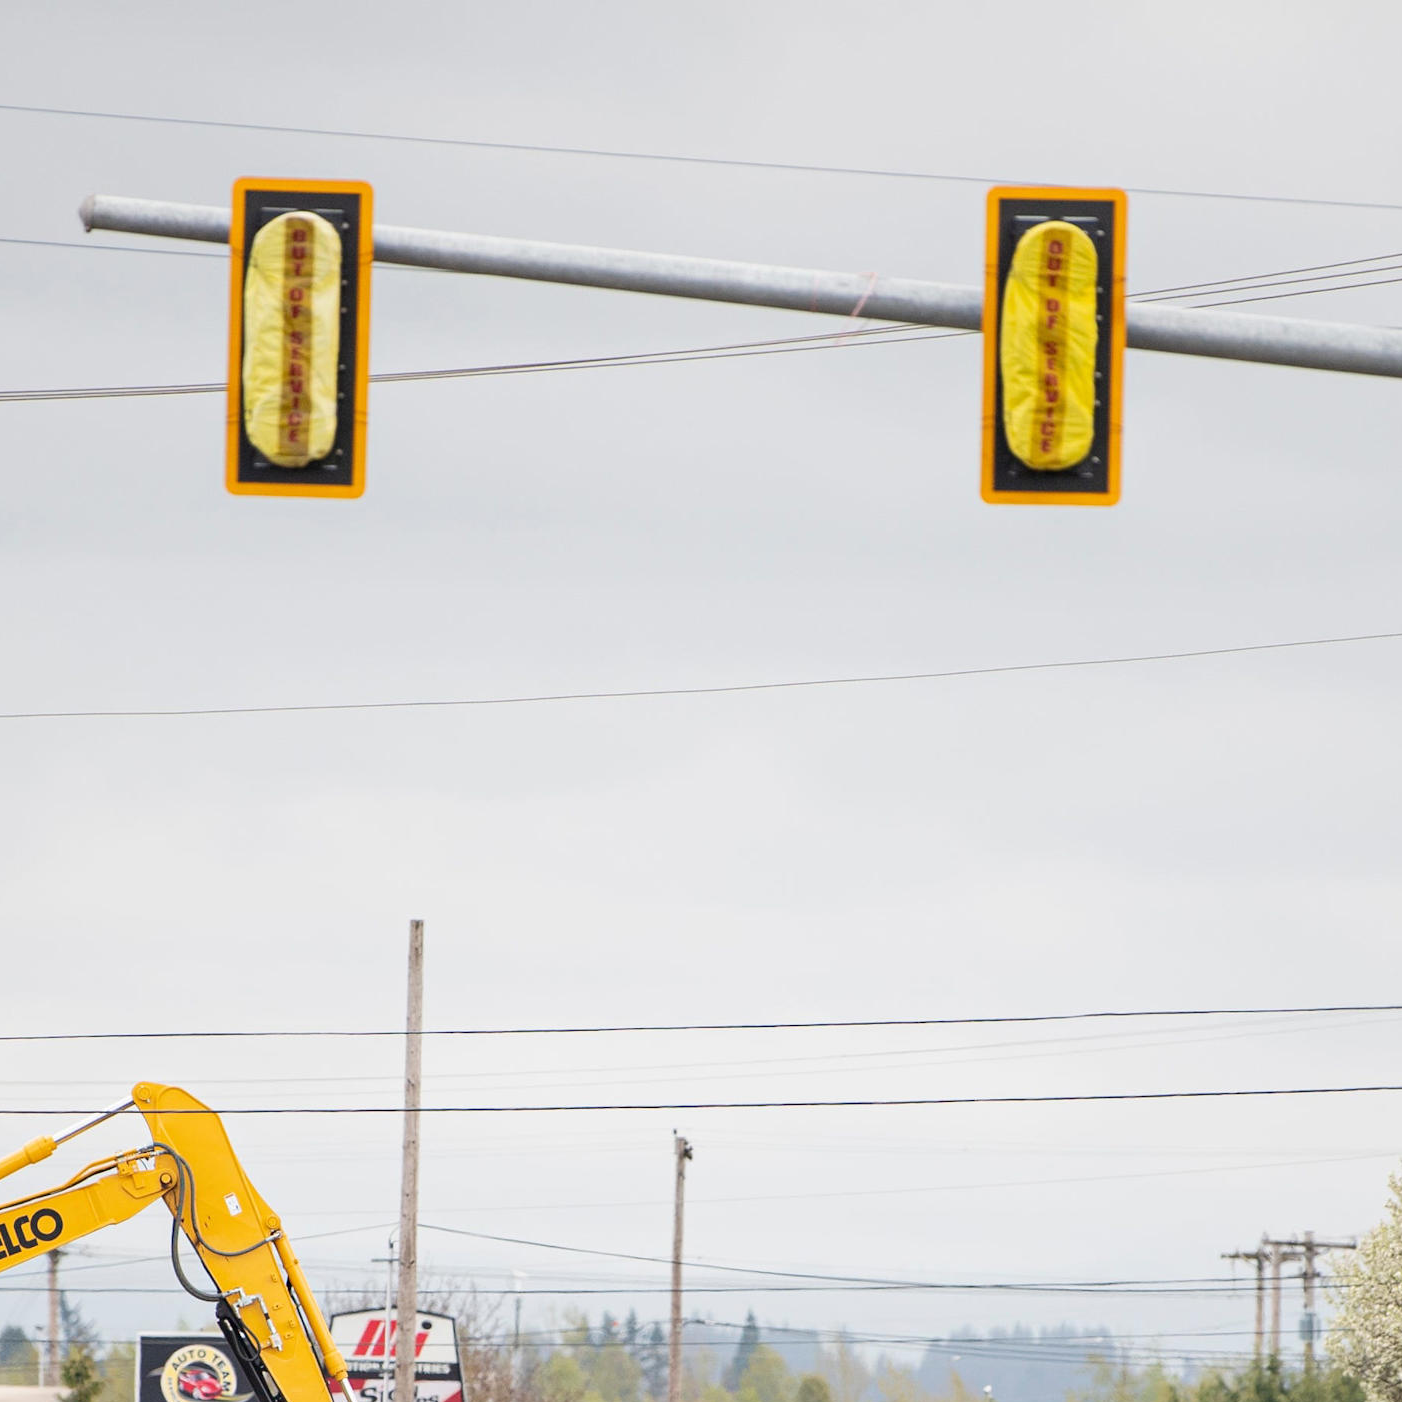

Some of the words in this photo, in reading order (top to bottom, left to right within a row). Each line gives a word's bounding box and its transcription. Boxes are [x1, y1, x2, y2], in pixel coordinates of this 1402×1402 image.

[1046, 239, 1063, 288] OUT
[1045, 299, 1060, 330] OF
[1040, 340, 1060, 453] SERVICE
[171, 1348, 207, 1372] AUTO
[212, 1353, 232, 1394] TEAM
